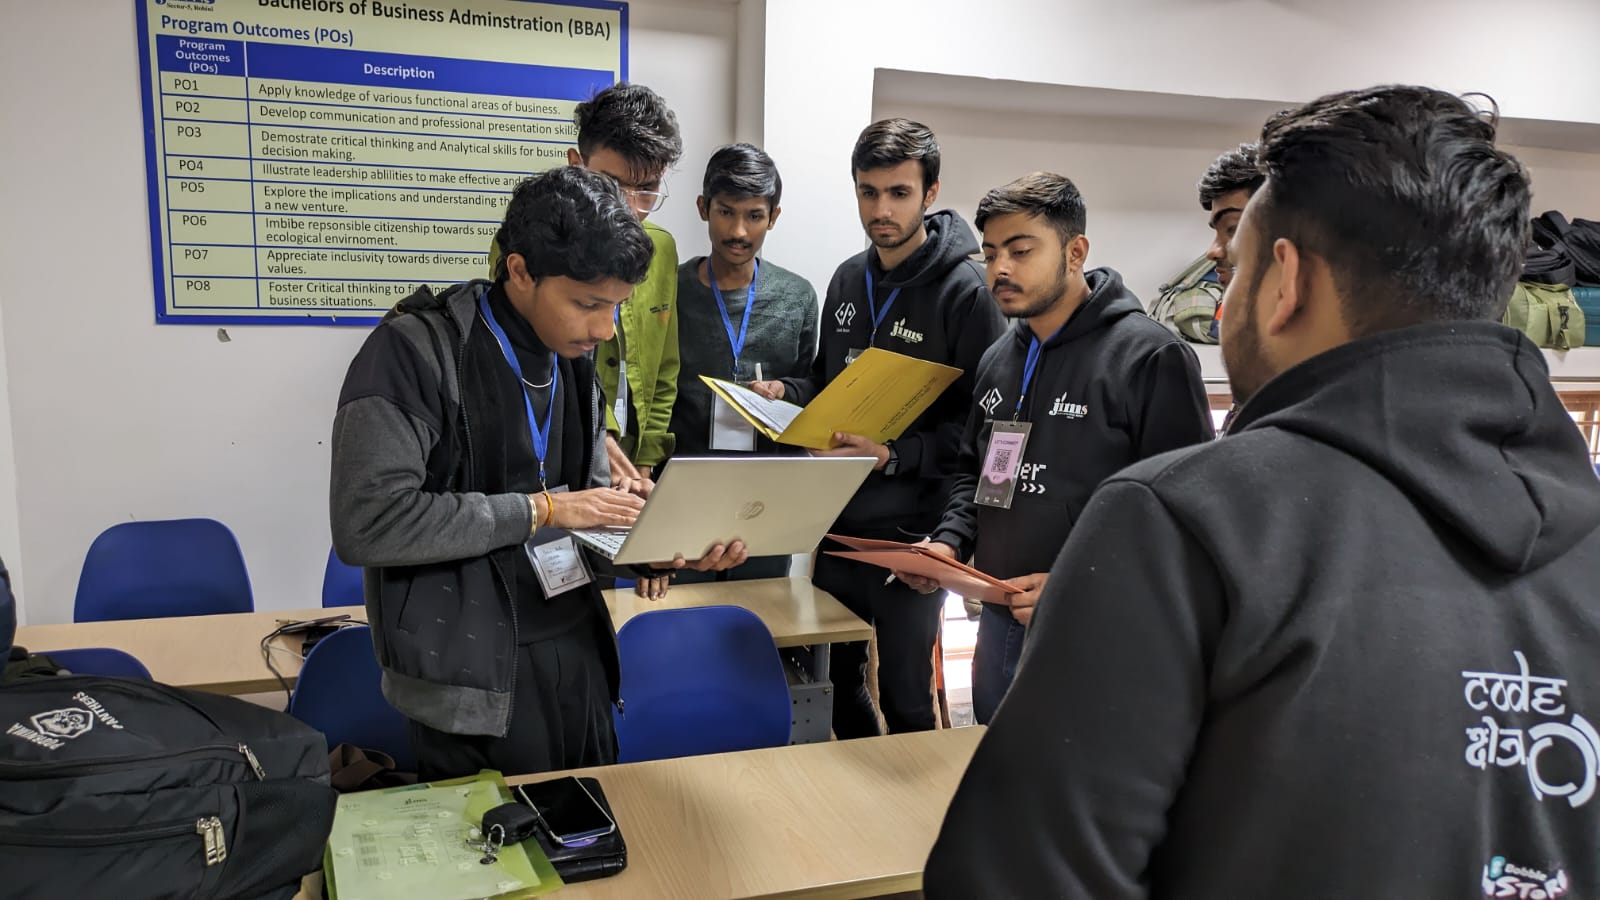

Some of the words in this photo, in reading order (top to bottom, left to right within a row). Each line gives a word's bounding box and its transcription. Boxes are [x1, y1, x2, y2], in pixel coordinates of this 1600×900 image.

[258, 0, 344, 14] Bachelors
[350, 0, 367, 15] of
[372, 1, 444, 22] Business
[450, 8, 564, 33] Adminstration
[568, 18, 611, 41] (BBA)
[161, 15, 229, 34] Program
[233, 21, 310, 41] Outcomes
[314, 26, 354, 46] (POs)
[179, 39, 225, 52] Program
[175, 50, 230, 63] Outcomes
[189, 62, 219, 74] (POs)
[364, 63, 436, 80] Description
[174, 79, 199, 91] PO1
[258, 84, 292, 98] Apply
[295, 86, 356, 103] knowledge
[359, 90, 371, 101] of
[373, 92, 412, 105] various
[415, 94, 468, 108] functional
[472, 100, 499, 111] areas
[502, 100, 513, 112] of
[515, 102, 561, 115] business.
[176, 102, 200, 114] PO2
[260, 106, 307, 120] Develop
[310, 108, 396, 124] communication
[399, 115, 418, 126] and
[422, 116, 485, 132] professional
[488, 121, 552, 136] presentation
[554, 124, 579, 136] skills
[177, 126, 202, 138] PO3
[261, 131, 328, 146] Demostrate
[331, 134, 368, 148] critical
[370, 136, 414, 152] thinking
[417, 141, 437, 152] and
[440, 142, 490, 158] Analytical
[493, 144, 518, 156] skills
[520, 144, 534, 156] for
[536, 146, 568, 158] busine
[262, 146, 309, 159] decision
[312, 149, 356, 161] making.
[179, 160, 204, 172] PO4
[262, 163, 310, 176] Illustrate
[313, 166, 368, 181] leadership
[370, 167, 414, 182] ablilities
[416, 172, 427, 182] to
[429, 173, 456, 184] make
[458, 174, 501, 186] effective
[503, 176, 522, 186] and
[181, 182, 205, 193] PO5
[264, 186, 306, 200] Explore
[310, 188, 328, 198] the
[331, 188, 397, 202] implications
[400, 192, 420, 203] and
[422, 192, 497, 208] understanding
[499, 196, 510, 206] th
[265, 202, 272, 210] a
[274, 202, 298, 211] new
[302, 202, 348, 214] venture.
[182, 214, 207, 226] PO6
[266, 218, 305, 230] Imbibe
[308, 220, 371, 234] repsonsible
[374, 221, 430, 236] citizenship
[432, 224, 475, 235] towards
[477, 226, 498, 236] sust
[266, 232, 322, 246] ecological
[325, 234, 398, 246] envirnoment.
[184, 249, 208, 260] PO7
[267, 250, 328, 264] Appreciate
[331, 251, 384, 265] inclusivity
[387, 254, 430, 264] towards
[433, 254, 470, 266] diverse
[268, 264, 307, 274] values.
[186, 280, 211, 292] PO8
[269, 281, 302, 293] Foster
[306, 282, 344, 294] Critical
[347, 282, 392, 296] thinking
[394, 284, 405, 294] to
[270, 295, 318, 306] business
[320, 296, 376, 308] situations.
[1048, 392, 1088, 416] jims
